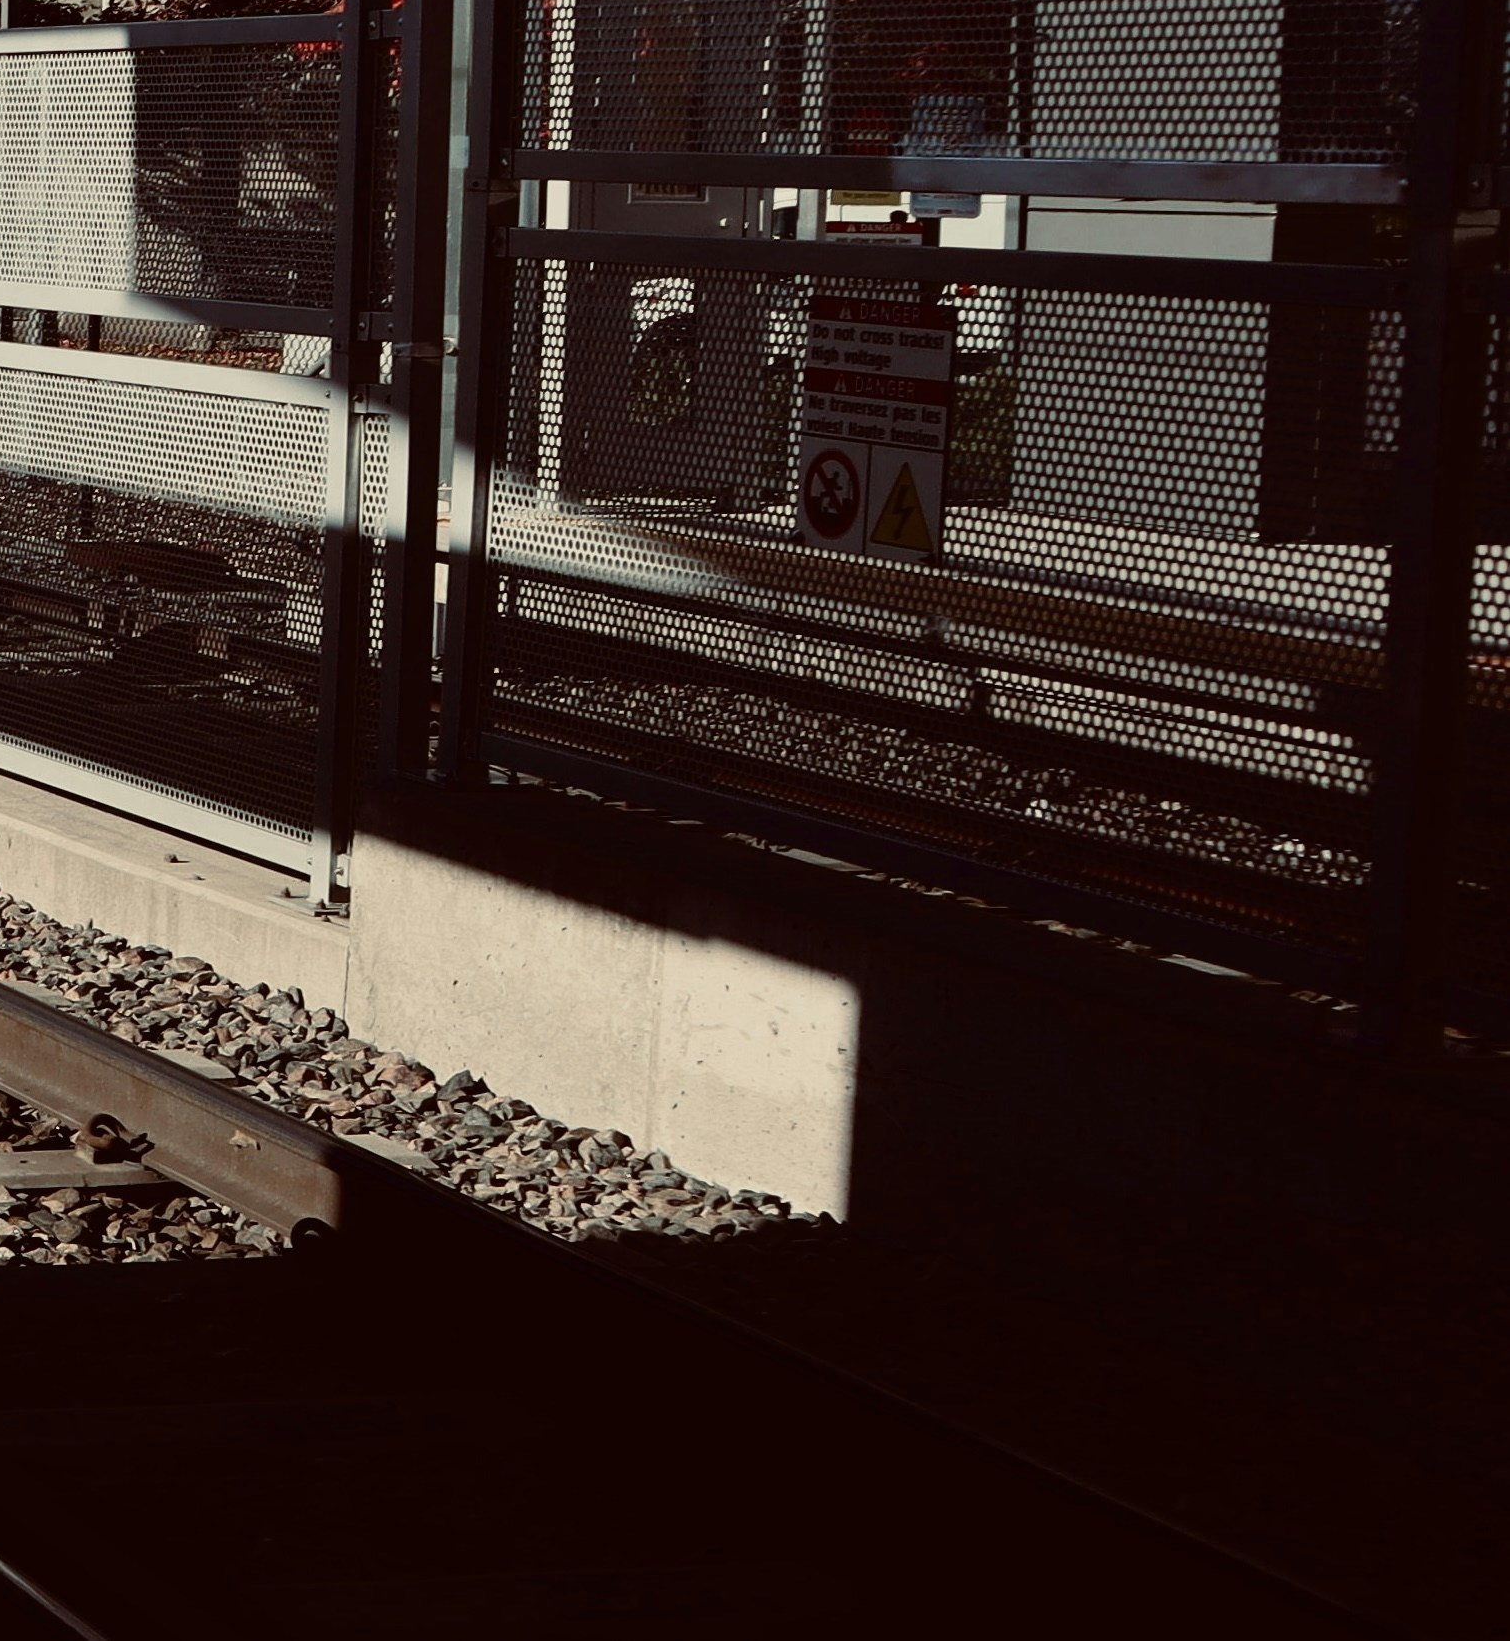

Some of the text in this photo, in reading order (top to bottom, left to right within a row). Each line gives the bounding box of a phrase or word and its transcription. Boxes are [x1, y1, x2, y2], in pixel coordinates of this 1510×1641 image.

[860, 223, 903, 233] DANGER
[859, 303, 921, 325] DANGER
[813, 324, 945, 350] Do not cross tracks!
[811, 345, 892, 371] High voltage
[855, 376, 916, 399] DANGER
[808, 395, 942, 424] Ne traversez pas les
[807, 418, 939, 446] voies! Haute tension
